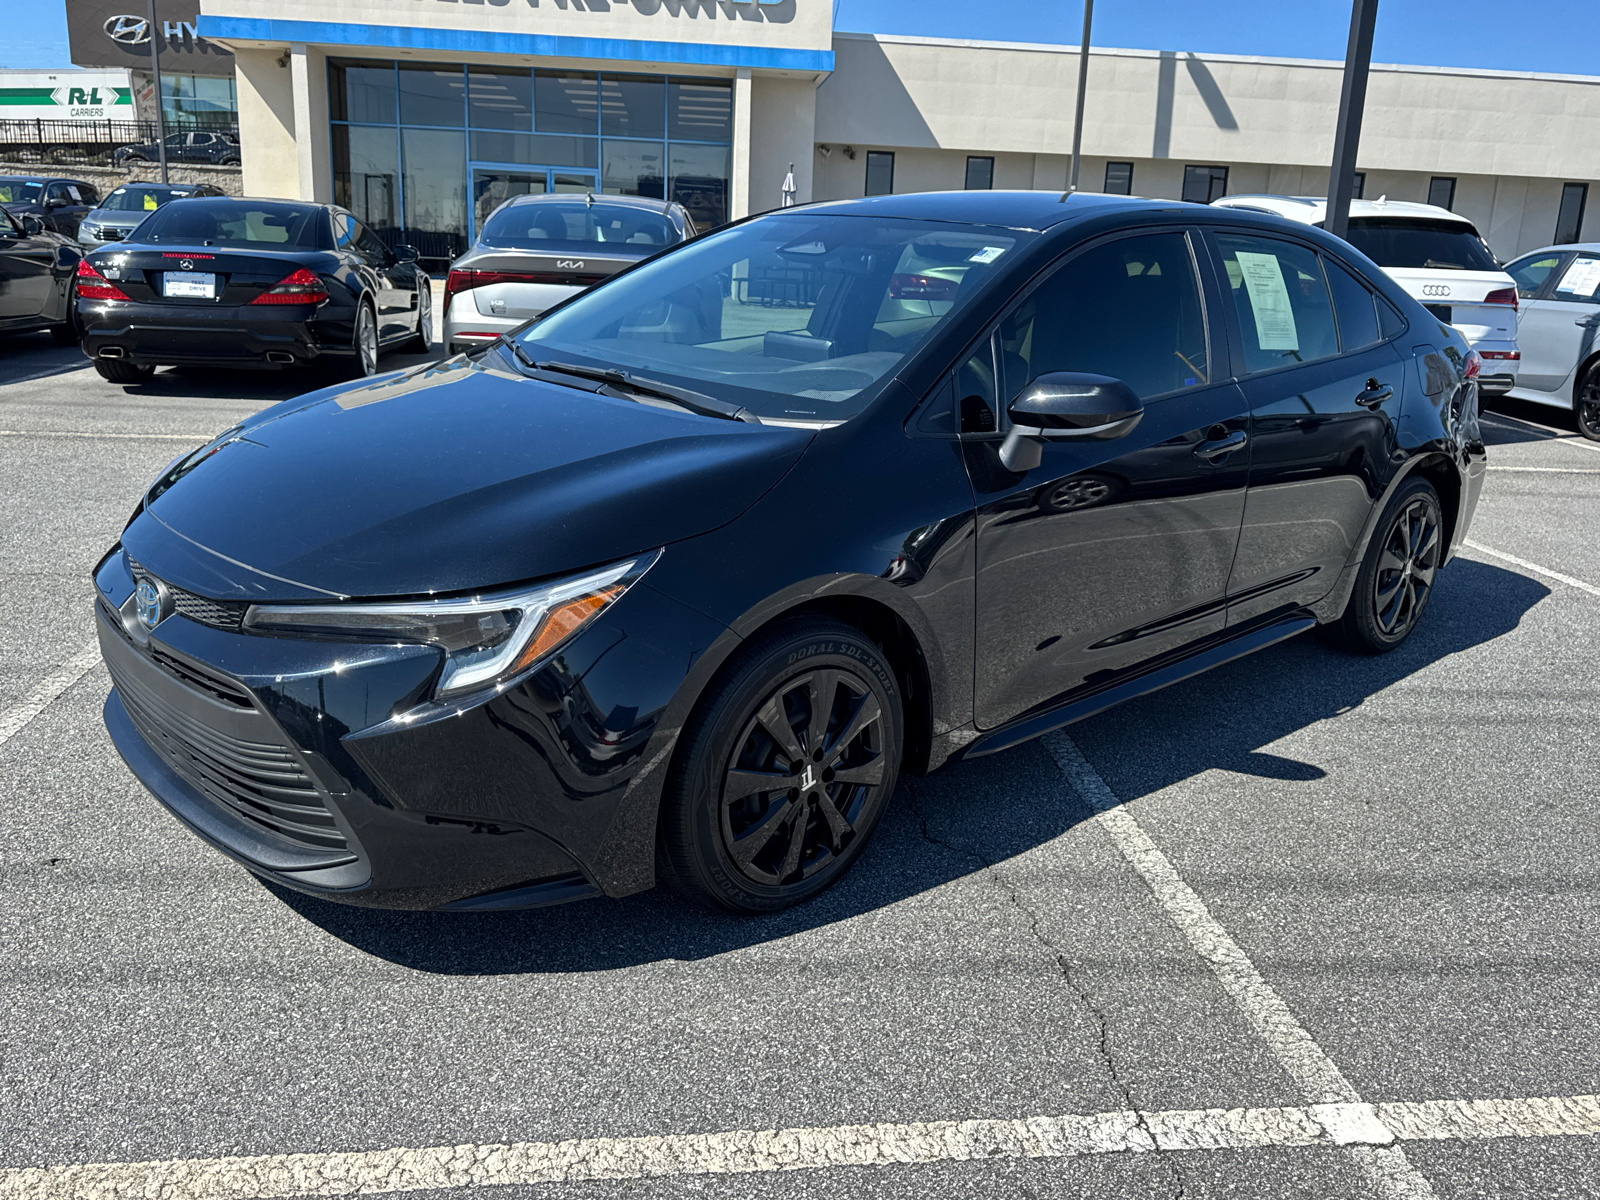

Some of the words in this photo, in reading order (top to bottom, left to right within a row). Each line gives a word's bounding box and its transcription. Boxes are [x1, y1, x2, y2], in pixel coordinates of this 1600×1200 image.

[68, 87, 103, 105] R+L
[70, 107, 104, 118] CARRIERS
[556, 260, 584, 269] KIA
[787, 642, 835, 665] DORAL
[839, 643, 895, 696] SDL-SPORT
